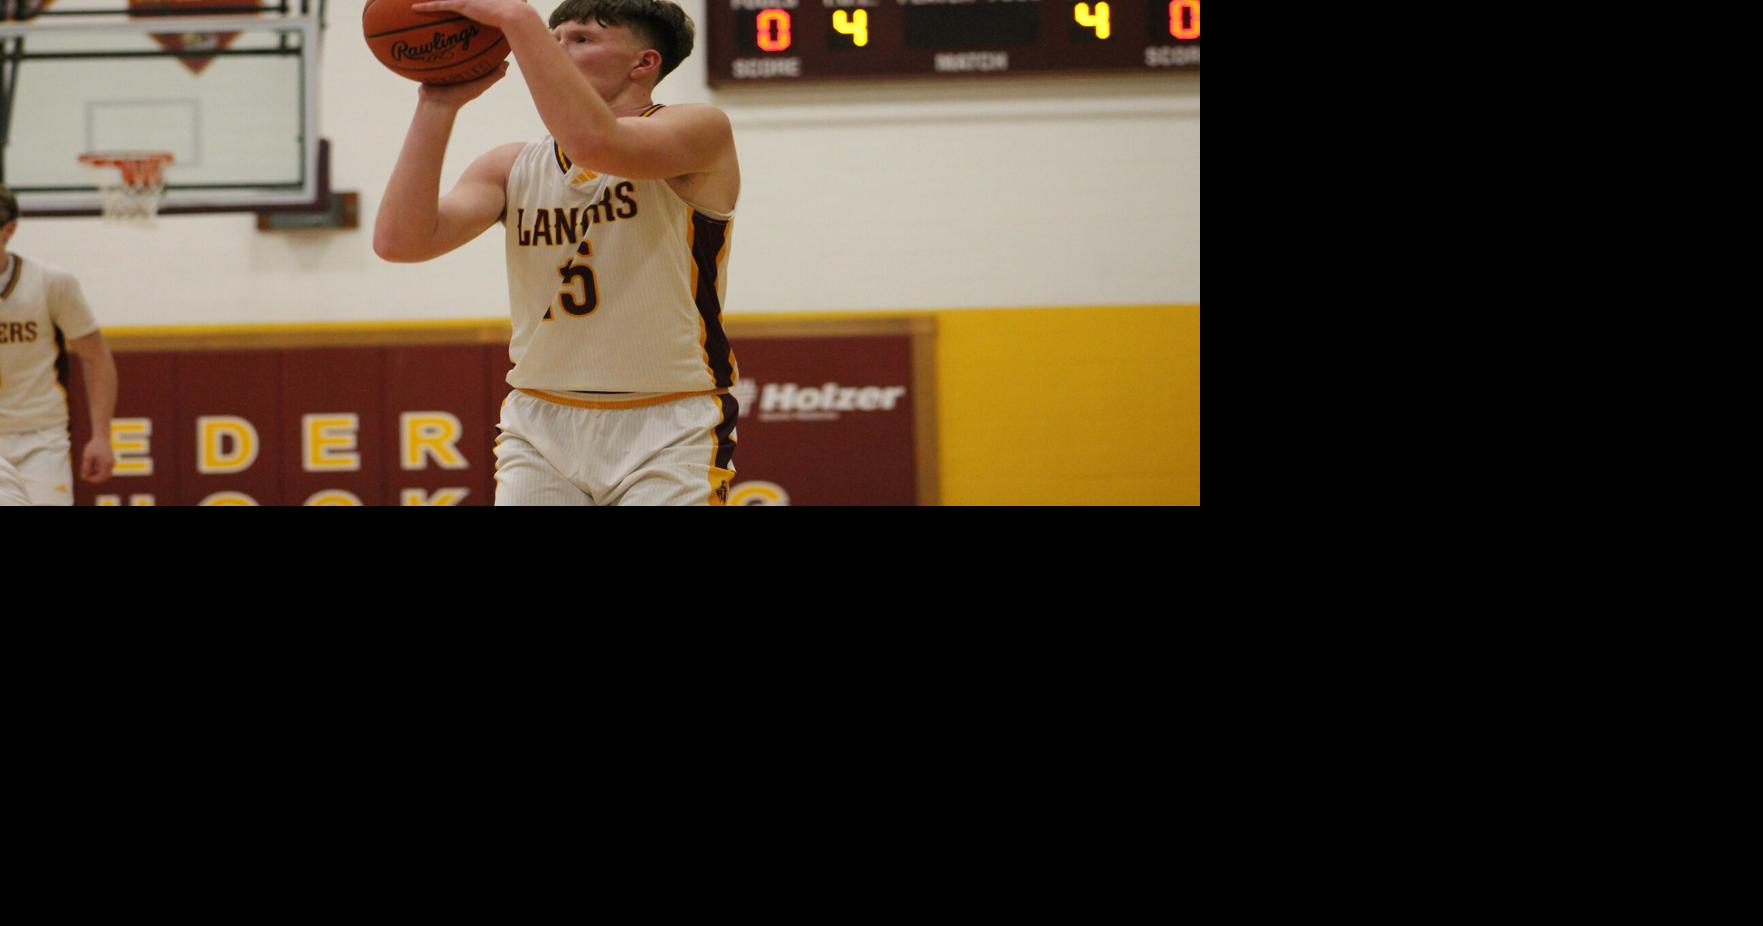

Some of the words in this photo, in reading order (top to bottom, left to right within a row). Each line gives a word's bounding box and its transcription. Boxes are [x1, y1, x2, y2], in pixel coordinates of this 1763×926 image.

[756, 8, 791, 51] 0
[832, 9, 868, 46] 4
[1075, 2, 1110, 39] 4
[1169, 0, 1200, 39] 0
[391, 25, 480, 61] Rawlings
[732, 58, 800, 78] SCORE
[759, 382, 906, 412] Holzer
